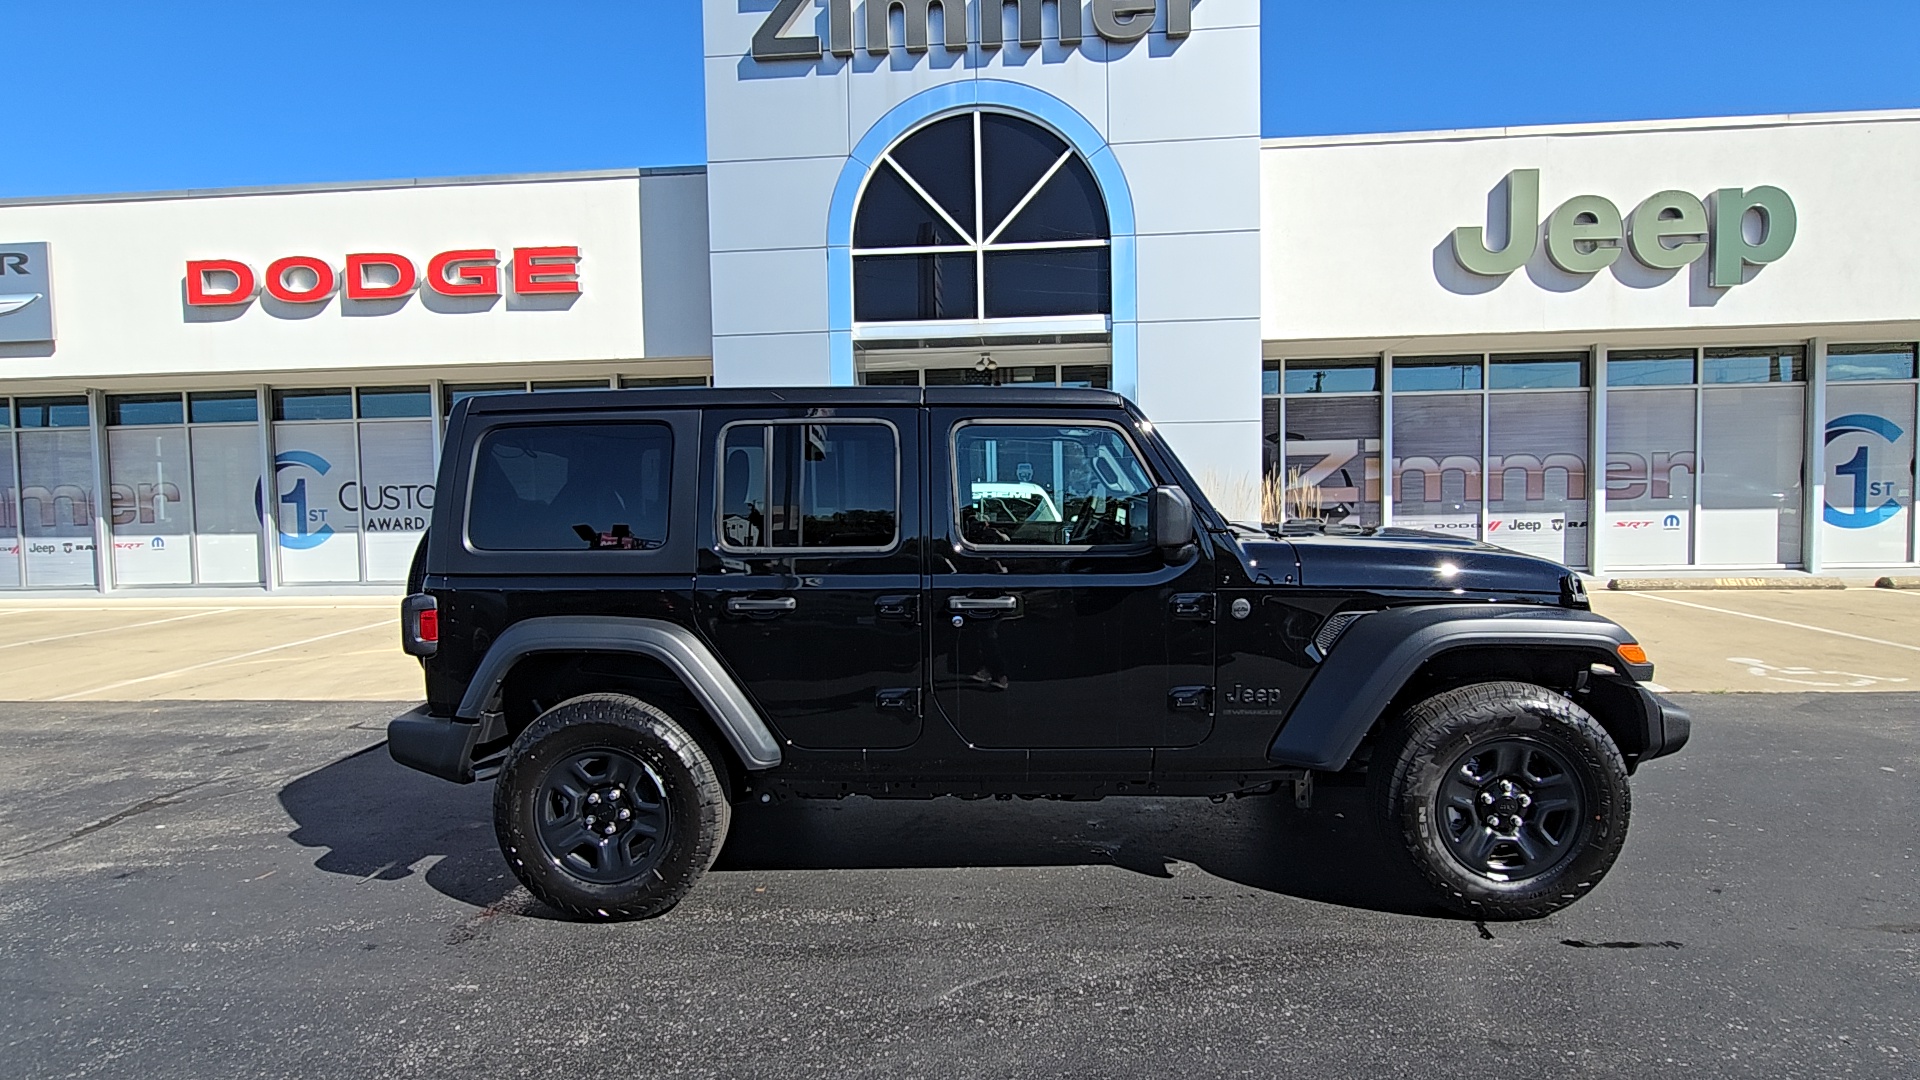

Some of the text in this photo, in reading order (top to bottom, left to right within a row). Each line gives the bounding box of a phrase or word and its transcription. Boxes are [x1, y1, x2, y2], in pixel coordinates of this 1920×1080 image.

[1453, 169, 1797, 287] Jeep
[186, 246, 582, 306] DODGE
[1284, 438, 1705, 503] Zimmer
[366, 517, 425, 531] AWARD
[1508, 519, 1541, 532] Jeep
[29, 542, 55, 554] Jeep
[1225, 683, 1282, 708] Jeep
